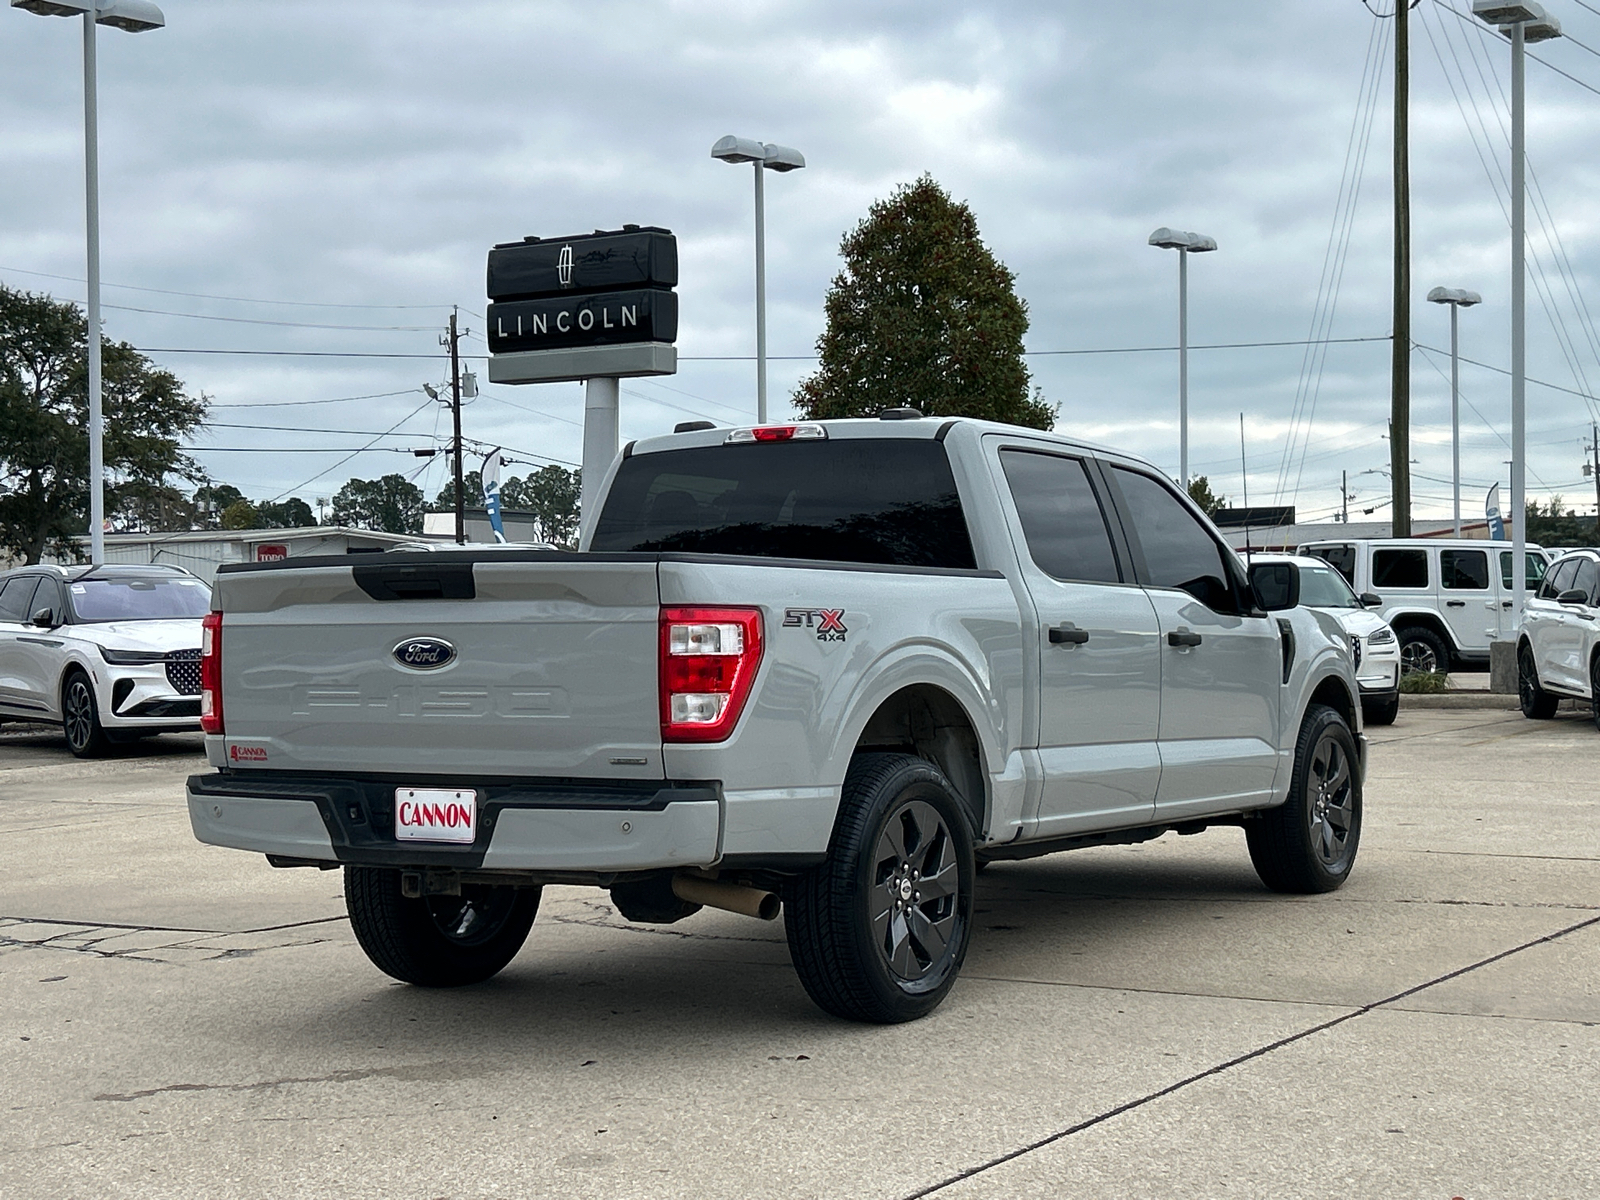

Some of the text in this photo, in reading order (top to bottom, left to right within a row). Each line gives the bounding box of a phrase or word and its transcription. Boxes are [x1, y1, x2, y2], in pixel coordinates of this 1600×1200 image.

[498, 305, 637, 337] LINCOLN
[782, 607, 848, 633] STX
[405, 643, 440, 662] Ford
[291, 684, 571, 718] F-150
[238, 746, 267, 756] CANNON
[399, 801, 472, 828] CANNON
